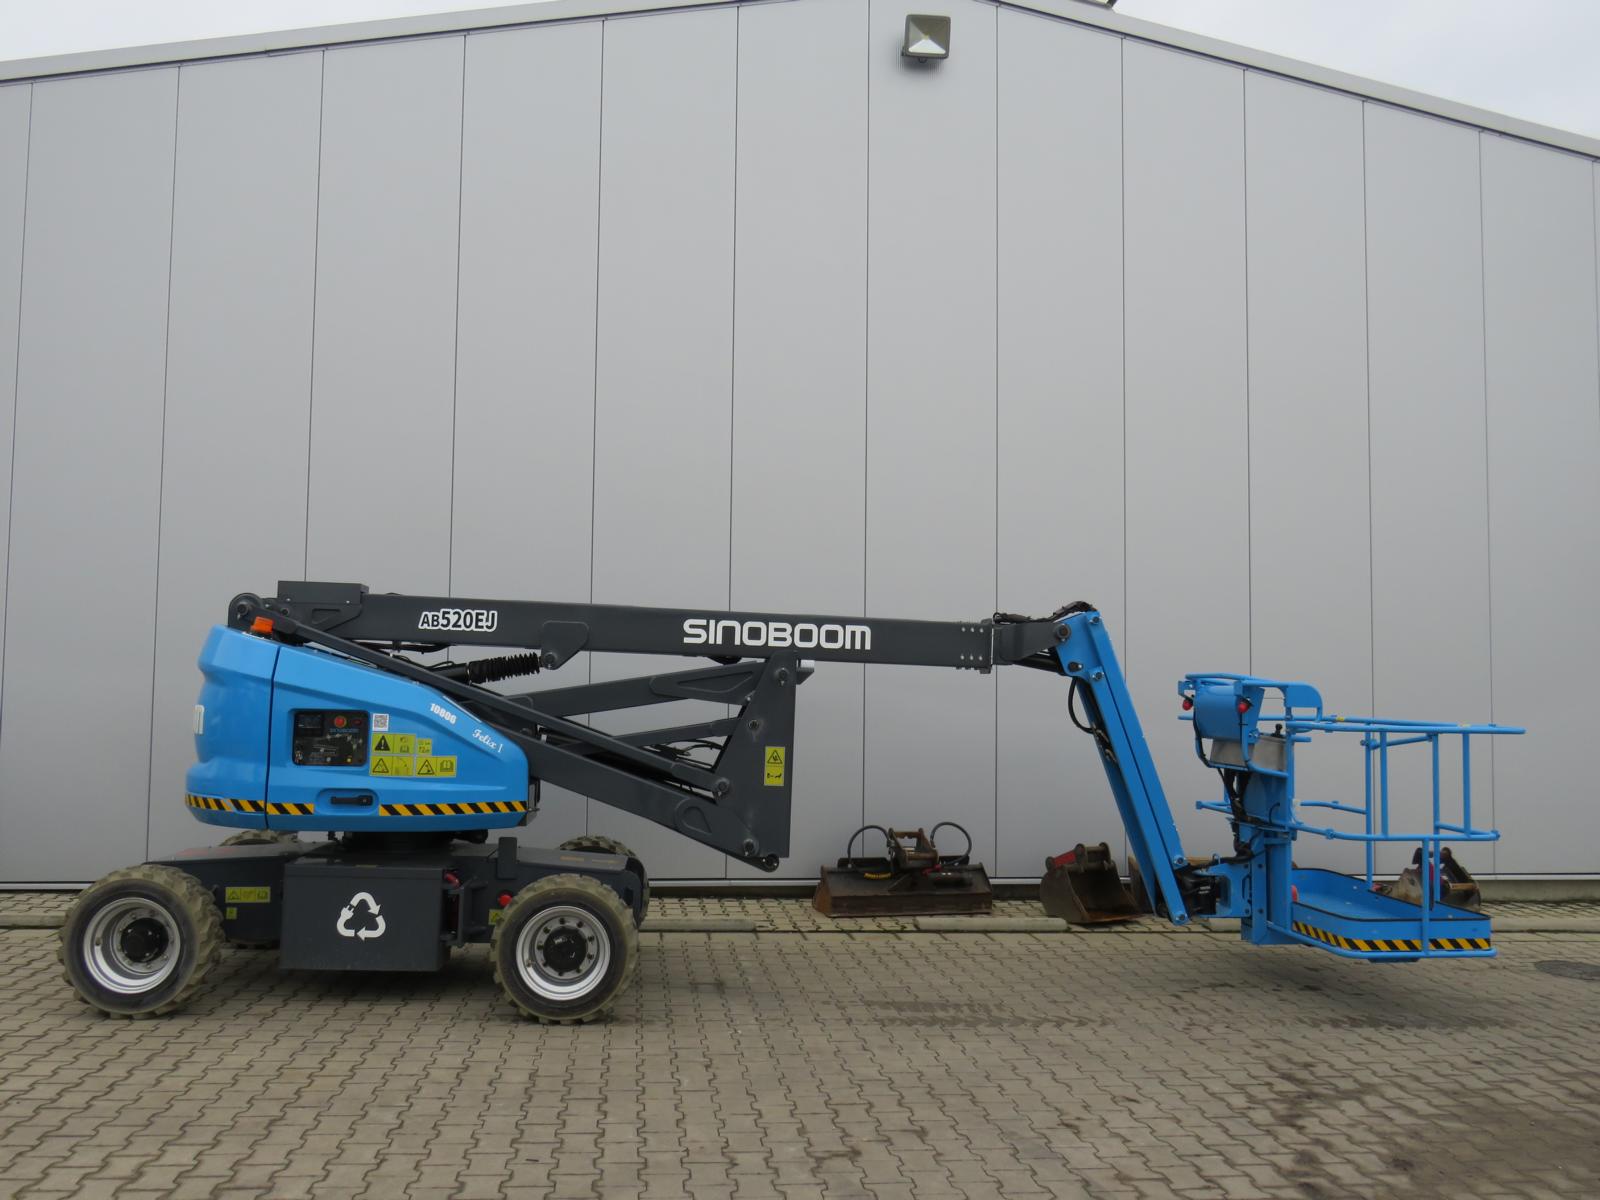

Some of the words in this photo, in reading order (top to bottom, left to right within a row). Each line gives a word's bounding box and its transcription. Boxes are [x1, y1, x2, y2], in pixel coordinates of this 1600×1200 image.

[418, 609, 498, 633] AB520EJ
[683, 619, 871, 650] SINOBOOM
[472, 729, 497, 749] Felix
